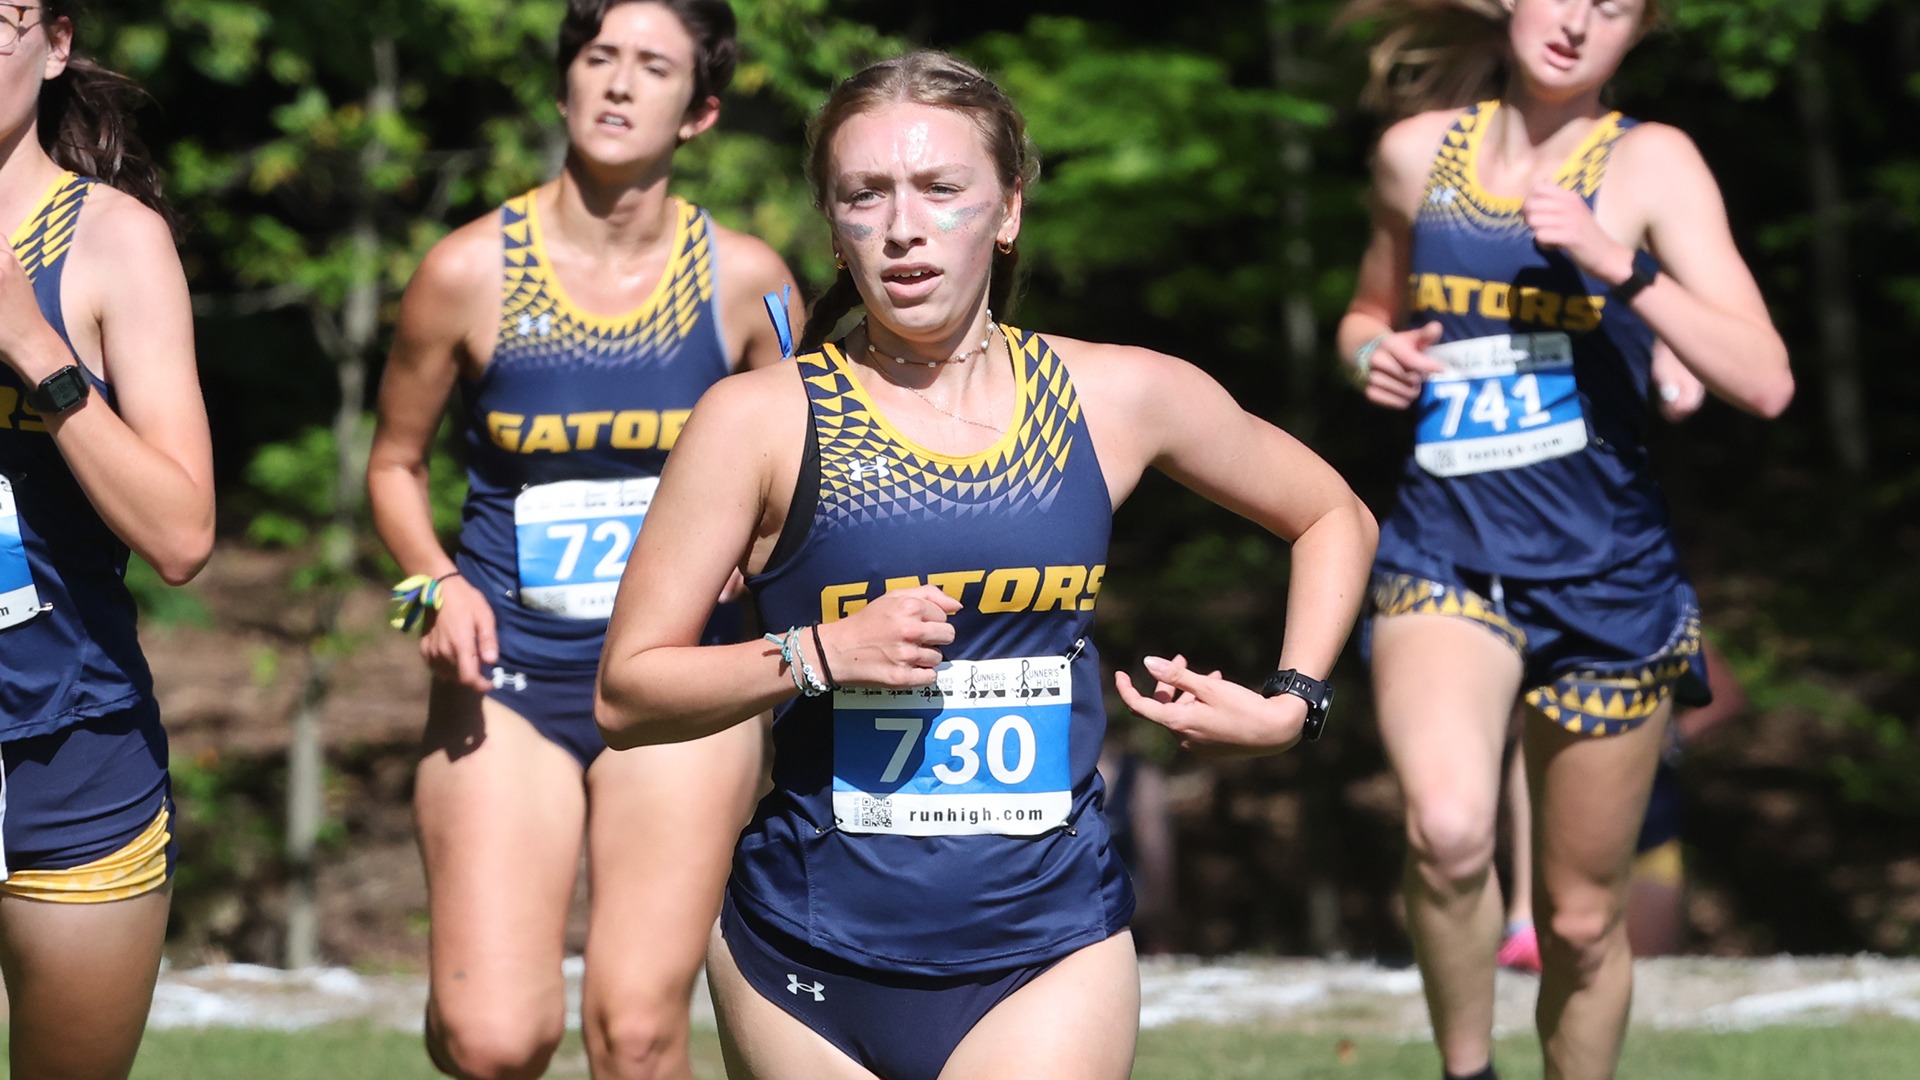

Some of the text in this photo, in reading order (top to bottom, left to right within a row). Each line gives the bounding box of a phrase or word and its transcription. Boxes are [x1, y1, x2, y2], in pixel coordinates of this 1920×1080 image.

[1408, 272, 1606, 332] ATORS
[1434, 373, 1551, 438] 741
[875, 714, 1036, 785] 730
[909, 807, 1043, 825] runhigh.com
